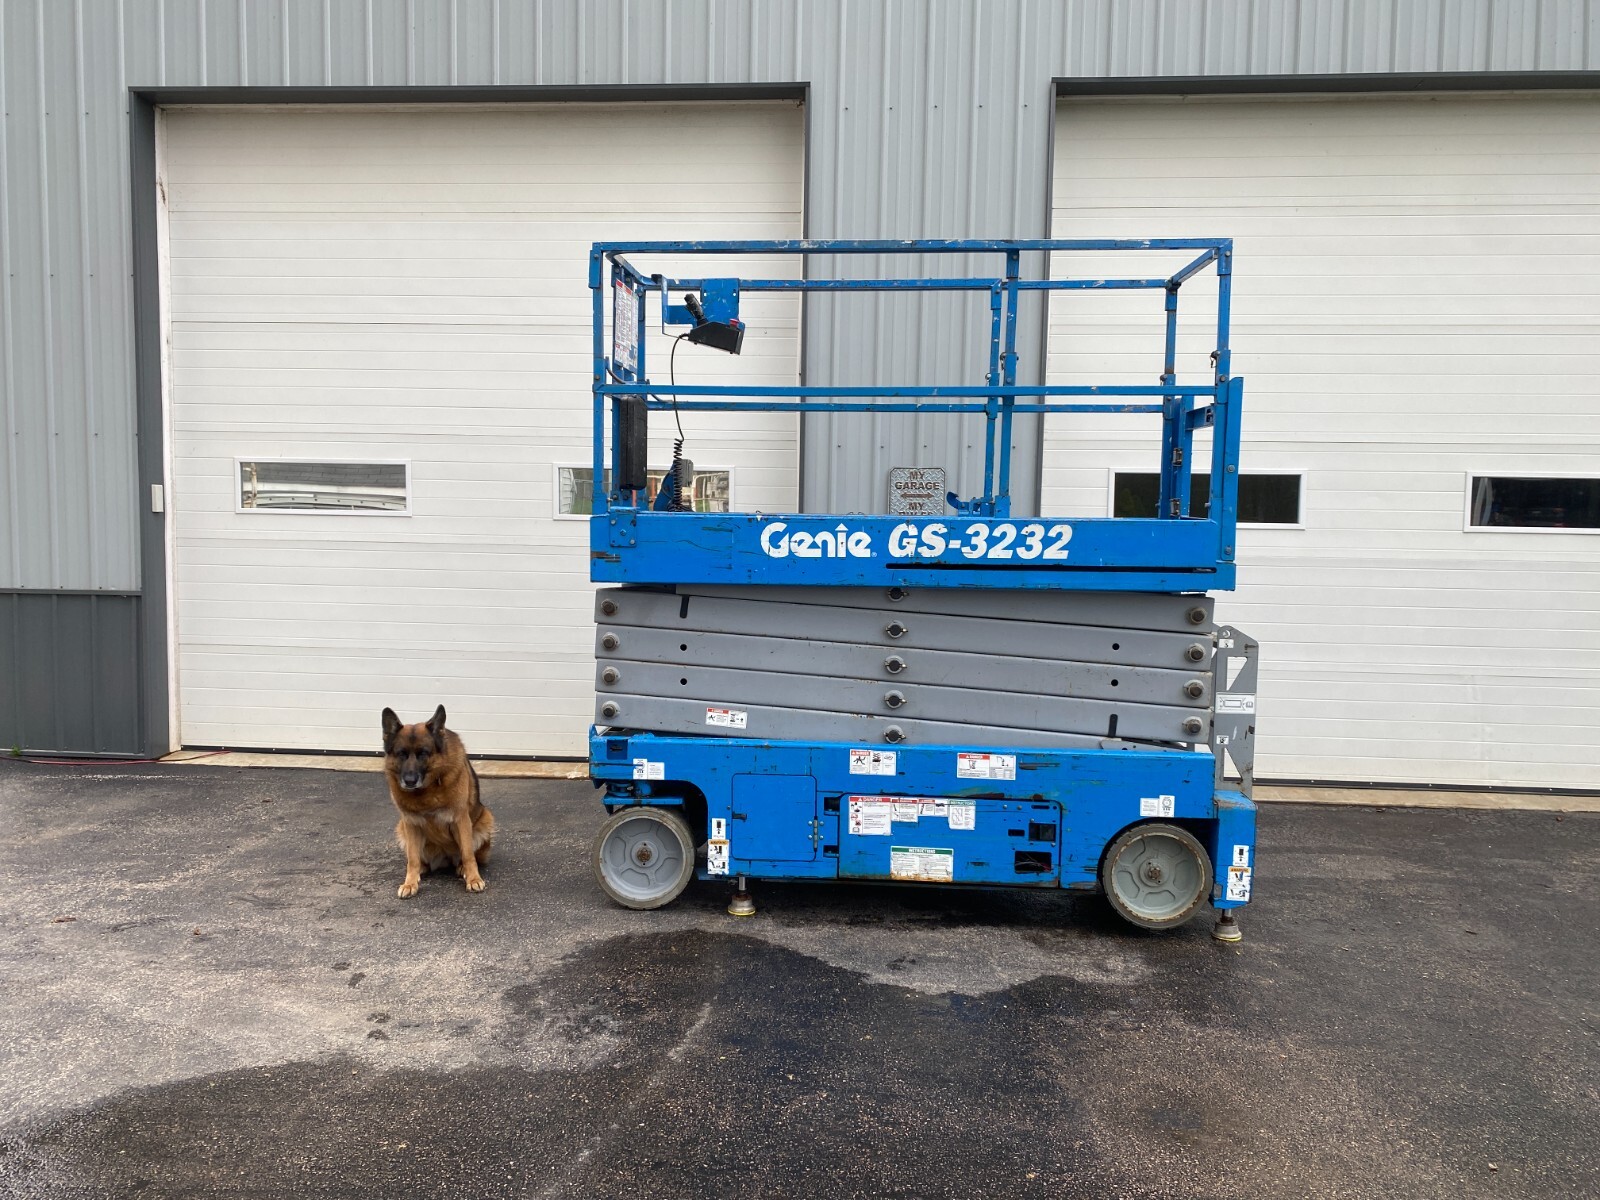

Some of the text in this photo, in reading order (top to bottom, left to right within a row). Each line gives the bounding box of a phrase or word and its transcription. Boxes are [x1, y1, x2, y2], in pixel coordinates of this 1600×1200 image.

[910, 471, 925, 480] MY
[895, 481, 940, 490] GARAGE
[909, 502, 923, 511] MY
[760, 521, 1073, 560] Genie GS-3232
